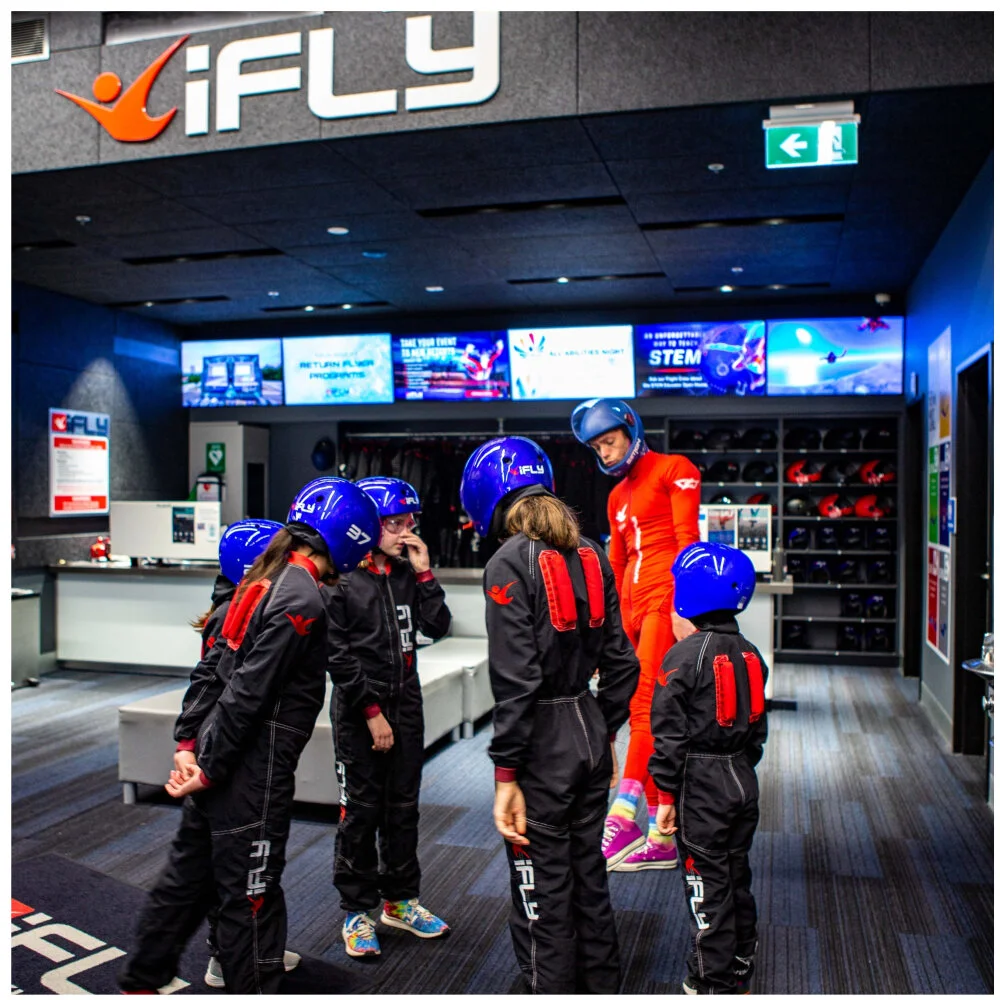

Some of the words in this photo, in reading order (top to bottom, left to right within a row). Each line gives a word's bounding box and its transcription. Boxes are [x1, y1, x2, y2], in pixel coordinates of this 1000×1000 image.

[185, 11, 500, 136] iFLY
[649, 349, 702, 365] STEM
[67, 414, 108, 437] iFLY
[519, 465, 544, 474] iFLY
[346, 524, 371, 545] 37
[245, 840, 270, 895] iFLY
[514, 859, 539, 920] iFLY
[686, 875, 710, 930] iFLY
[11, 912, 191, 995] iFL
